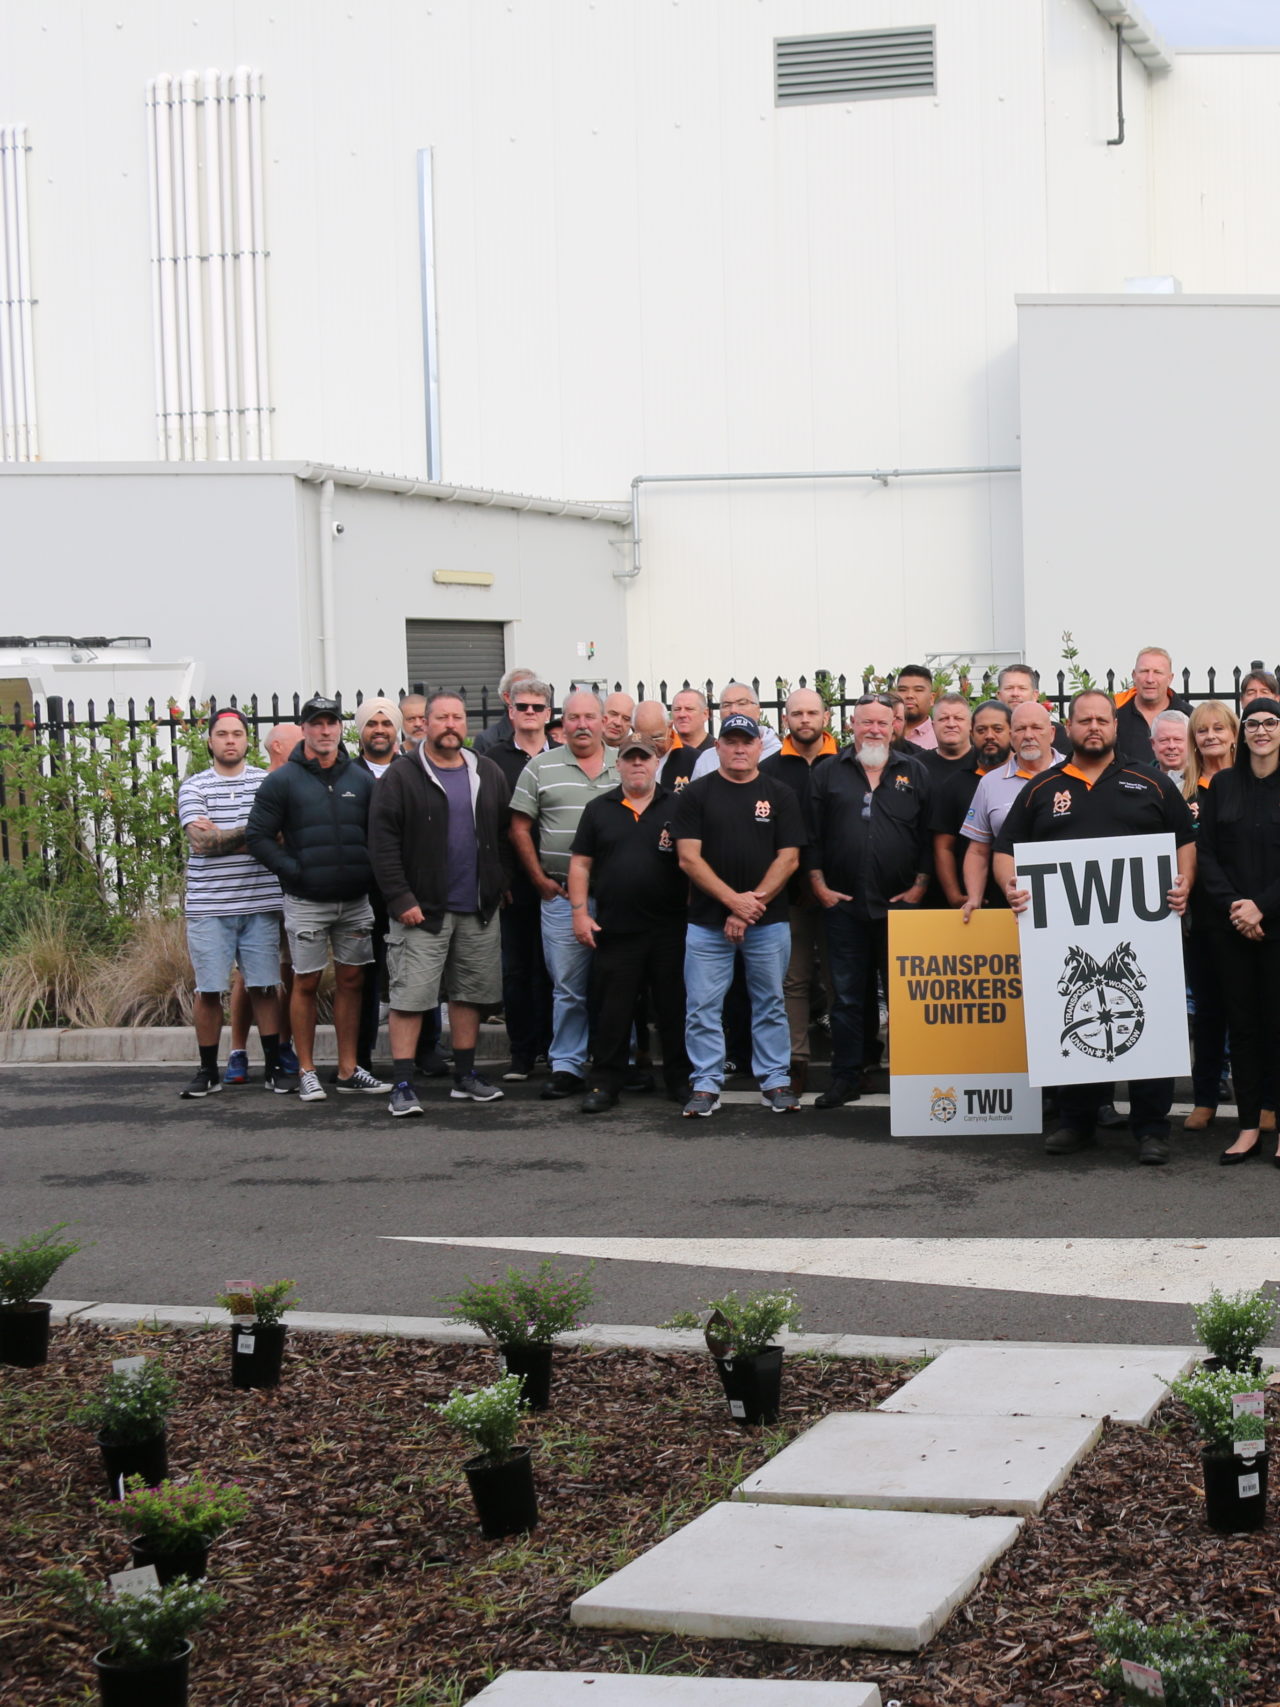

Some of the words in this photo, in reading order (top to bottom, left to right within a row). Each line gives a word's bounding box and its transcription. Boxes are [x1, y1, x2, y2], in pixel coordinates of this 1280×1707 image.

[1016, 855, 1173, 929] TWU
[896, 954, 1020, 976] TRANSPOR
[907, 978, 1022, 1001] WORKERS
[924, 1002, 1006, 1025] UNITED
[1065, 983, 1092, 1024] TRANSPORT
[1069, 1033, 1095, 1056] UNION
[1124, 1029, 1141, 1048] NSW
[963, 1088, 1013, 1114] TWU
